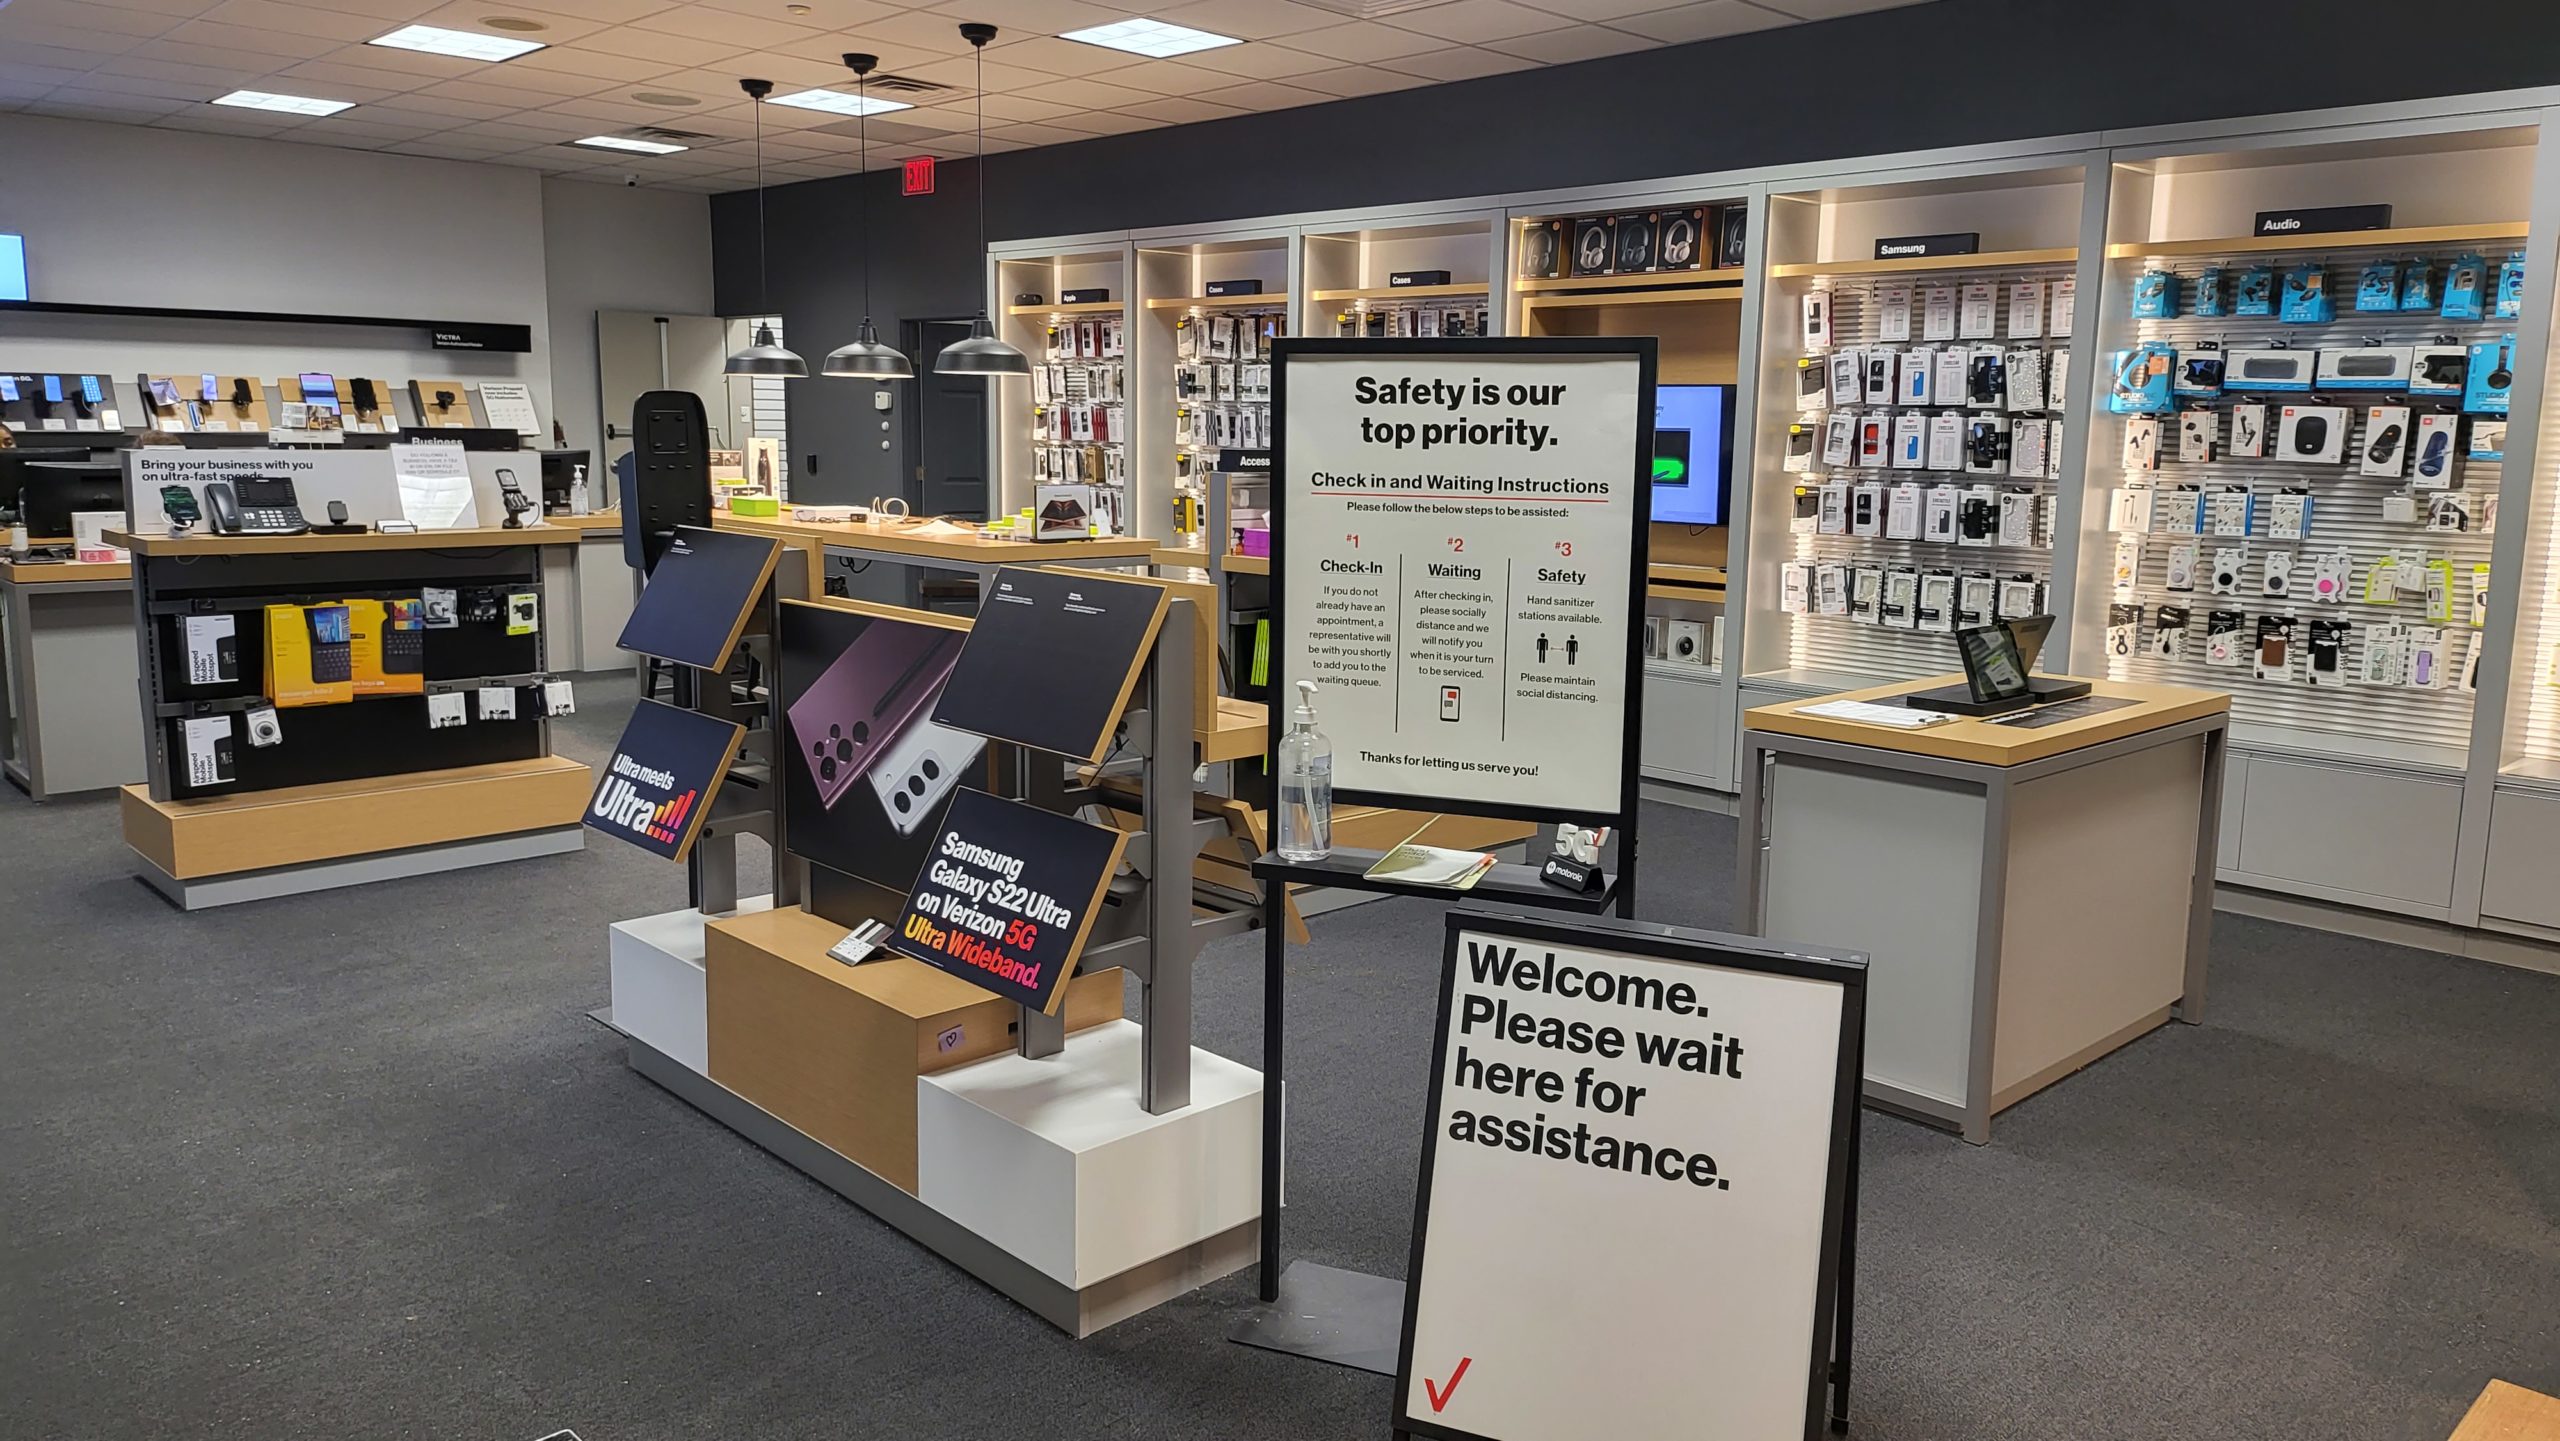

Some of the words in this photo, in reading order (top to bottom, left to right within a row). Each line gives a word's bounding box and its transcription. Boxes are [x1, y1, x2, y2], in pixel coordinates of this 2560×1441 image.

[906, 161, 929, 192] EXIT
[2263, 218, 2301, 231] Audio
[1880, 245, 1925, 255] Samsung
[1392, 276, 1411, 285] Cases
[1063, 294, 1076, 302] Apple
[1355, 376, 1466, 411] Safety
[1473, 377, 1500, 405] is
[1507, 385, 1566, 406] our
[1361, 417, 1415, 449] top
[1422, 417, 1558, 451] priority.
[412, 437, 463, 446] Business
[141, 460, 176, 471] Bring
[177, 461, 206, 471] your
[207, 460, 263, 470] business
[264, 460, 290, 470] with
[292, 461, 313, 471] you
[142, 473, 158, 482] on
[160, 471, 218, 482] ultra-fast
[1311, 472, 1366, 487] Check
[1371, 473, 1386, 488] in
[1390, 475, 1422, 489] and
[1426, 475, 1493, 494] Waiting
[1498, 476, 1609, 494] Instructions
[1347, 501, 1381, 512] Please
[1382, 503, 1413, 512] follow
[1414, 504, 1431, 513] the
[1432, 504, 1463, 514] below
[1465, 505, 1493, 517] steps
[1495, 506, 1506, 515] to
[1507, 506, 1520, 516] be
[1522, 507, 1569, 517] assisted:
[1346, 534, 1360, 549] #1
[1448, 539, 1464, 552] #2
[1555, 543, 1572, 557] #3
[1320, 559, 1382, 574] Check-In
[1428, 563, 1481, 581] Waiting
[1538, 568, 1586, 585] Safety
[1324, 586, 1330, 594] If
[1331, 588, 1348, 596] you
[1349, 587, 1362, 596] do
[1363, 588, 1378, 597] not
[1414, 590, 1437, 599] After
[1439, 591, 1479, 603] checking
[1483, 593, 1493, 603] in,
[1316, 600, 1349, 612] already
[1350, 602, 1373, 611] have
[1527, 595, 1552, 605] Hand
[1554, 597, 1595, 607] sanitizer
[1420, 605, 1450, 615] please
[1452, 607, 1487, 619] socially
[1518, 611, 1556, 621] stations
[1557, 613, 1602, 624] available.
[1317, 616, 1377, 628] appointment,
[1416, 620, 1455, 631] distance
[1457, 623, 1474, 632] and
[1475, 625, 1489, 633] we
[1309, 632, 1375, 642] representative
[1376, 633, 1391, 642] will
[1421, 636, 1437, 645] will
[1438, 637, 1464, 648] notify
[1466, 640, 1483, 649] you
[1308, 645, 1320, 654] be
[1321, 645, 1340, 655] with
[1341, 648, 1358, 657] you
[1360, 648, 1391, 659] shortly
[1410, 650, 1435, 660] when
[1436, 651, 1442, 660] it
[1444, 652, 1451, 661] is
[1453, 655, 1473, 663] your
[1475, 654, 1494, 664] turn
[192, 650, 200, 682] Airspeed
[207, 653, 215, 681] Hotspot
[1313, 660, 1322, 669] to
[1323, 661, 1341, 669] add
[1342, 663, 1359, 671] you
[1360, 663, 1370, 671] to
[1371, 663, 1386, 672] the
[1419, 666, 1428, 675] to
[1430, 666, 1441, 676] be
[1443, 668, 1484, 678] serviced.
[1317, 676, 1349, 686] waiting
[1351, 678, 1381, 687] queue.
[1520, 672, 1552, 683] Please
[1554, 676, 1595, 686] maintain
[1517, 689, 1544, 698] social
[1546, 690, 1598, 703] distancing.
[191, 753, 199, 784] Airspeed
[205, 755, 213, 782] Hotspot
[1360, 751, 1402, 764] Thanks
[1404, 755, 1421, 766] for
[1422, 756, 1459, 771] letting
[1461, 762, 1475, 770] us
[1477, 763, 1511, 774] serve
[1513, 765, 1538, 776] you!
[613, 753, 641, 780] Ultra
[638, 766, 675, 790] meets
[1555, 823, 1598, 865] 5G
[941, 831, 1024, 882] Samsung
[1555, 867, 1582, 882] motorola
[930, 859, 991, 903] Galaxy
[987, 879, 1028, 913] S22
[1025, 892, 1072, 930] Ultra
[916, 891, 941, 914] on
[941, 893, 1006, 940] Verizon
[1005, 918, 1037, 951] 5G
[904, 913, 947, 950] Ultra
[947, 929, 1041, 990] Wideband.
[1467, 941, 1709, 1018] Welcome.
[1460, 994, 1625, 1058] Please
[1635, 1032, 1744, 1079] wait
[1455, 1046, 1564, 1103] here
[1574, 1067, 1646, 1117] for
[1449, 1110, 1729, 1191] assistance.
